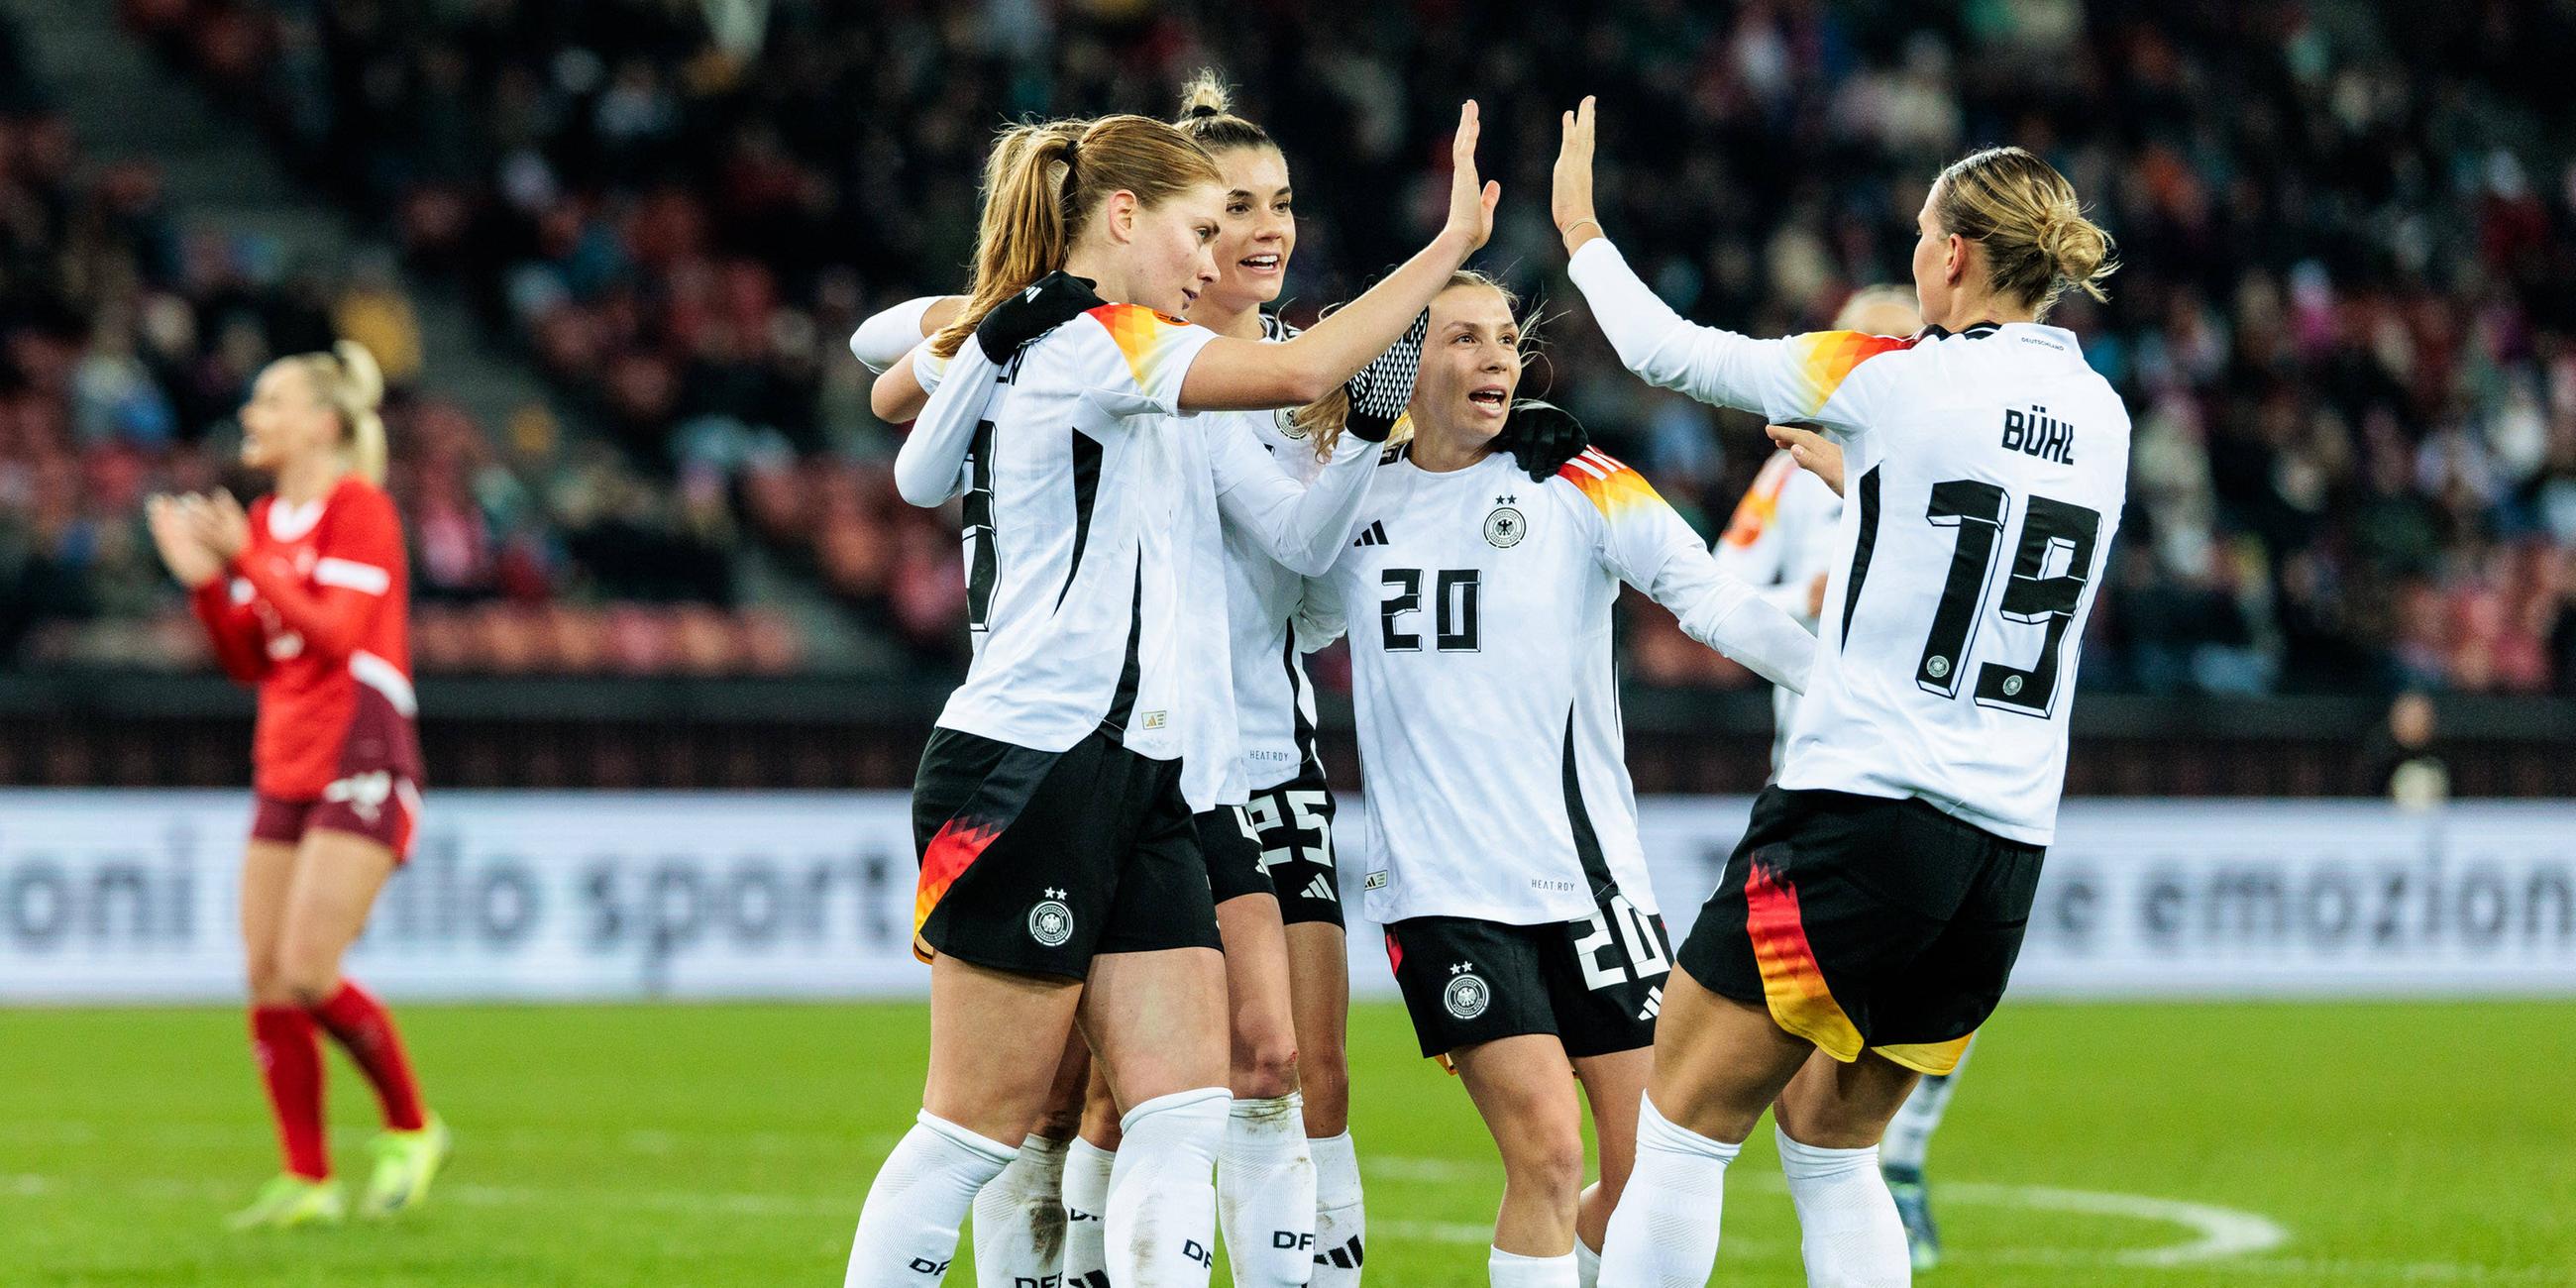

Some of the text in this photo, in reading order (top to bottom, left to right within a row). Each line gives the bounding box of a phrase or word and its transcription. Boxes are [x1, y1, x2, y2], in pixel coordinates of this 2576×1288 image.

[2021, 337, 2065, 351] DEUTSCHLAND
[2001, 404, 2074, 466] BÜHL
[1381, 568, 1482, 653] 20
[1916, 480, 2102, 720] 19
[579, 838, 897, 997] sport
[1568, 895, 1671, 991] 20
[1273, 1231, 1316, 1251] DF
